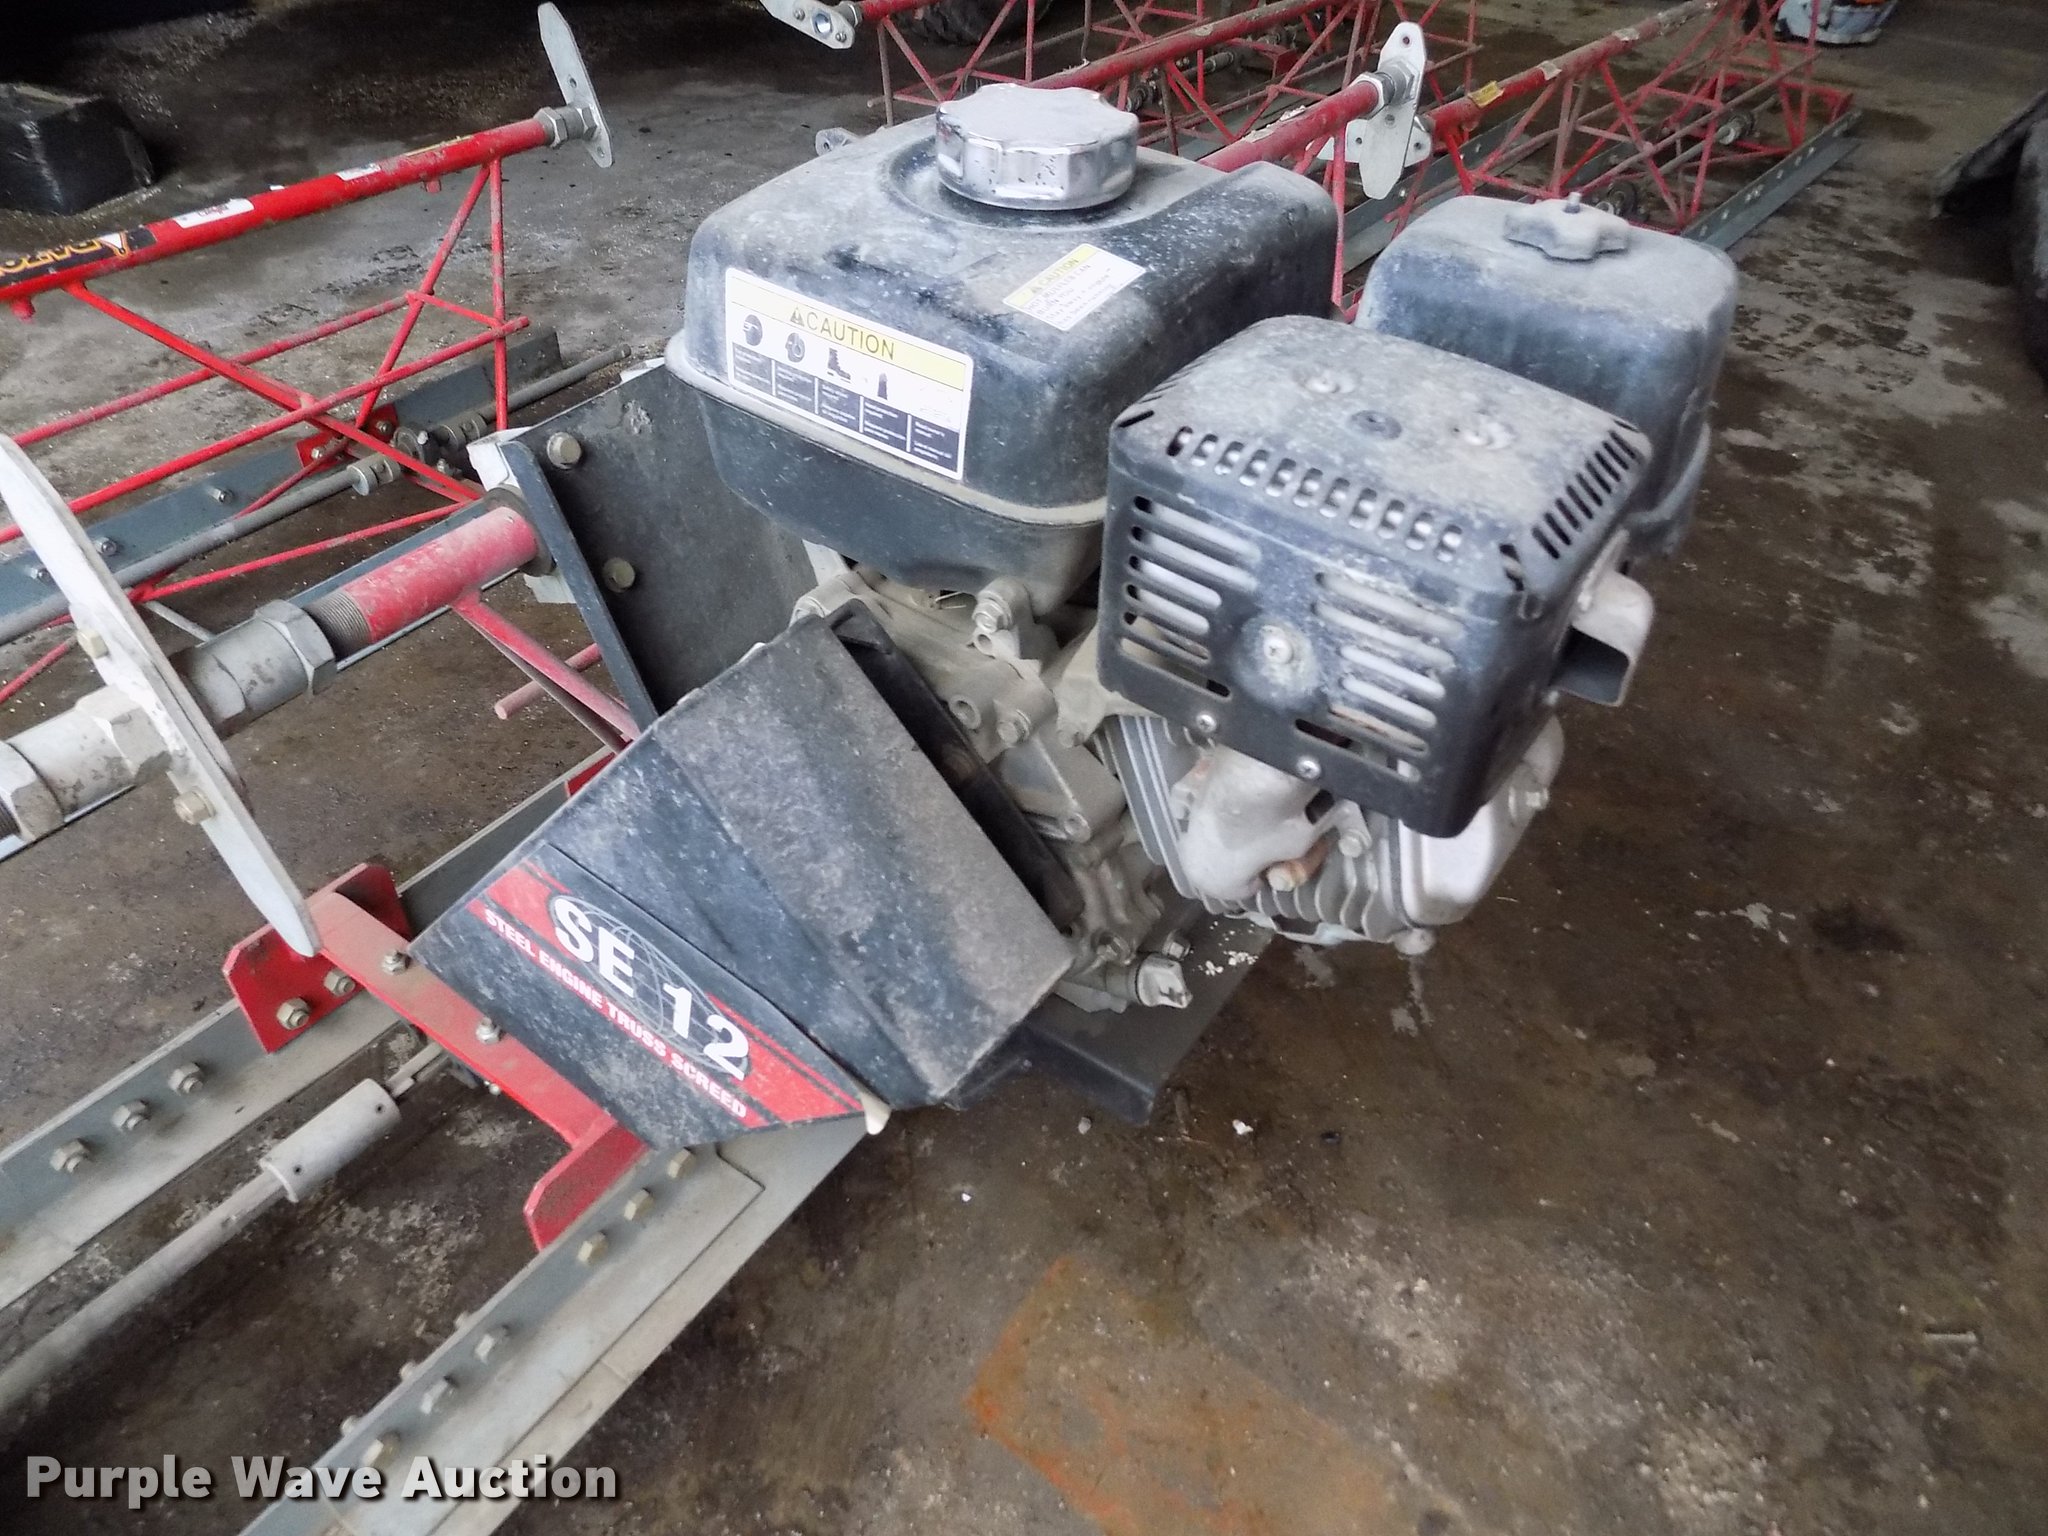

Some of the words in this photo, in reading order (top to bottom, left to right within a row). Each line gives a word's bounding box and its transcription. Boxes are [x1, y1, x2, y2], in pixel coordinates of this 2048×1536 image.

[1038, 257, 1079, 286] CAUTION
[806, 311, 895, 361] CAUTION
[484, 908, 536, 958] STEEL
[539, 949, 603, 1010] ENGINE
[607, 1002, 667, 1058] TRUSS
[670, 1051, 748, 1119] SCREED
[554, 898, 635, 998] SE
[663, 983, 749, 1081] 12
